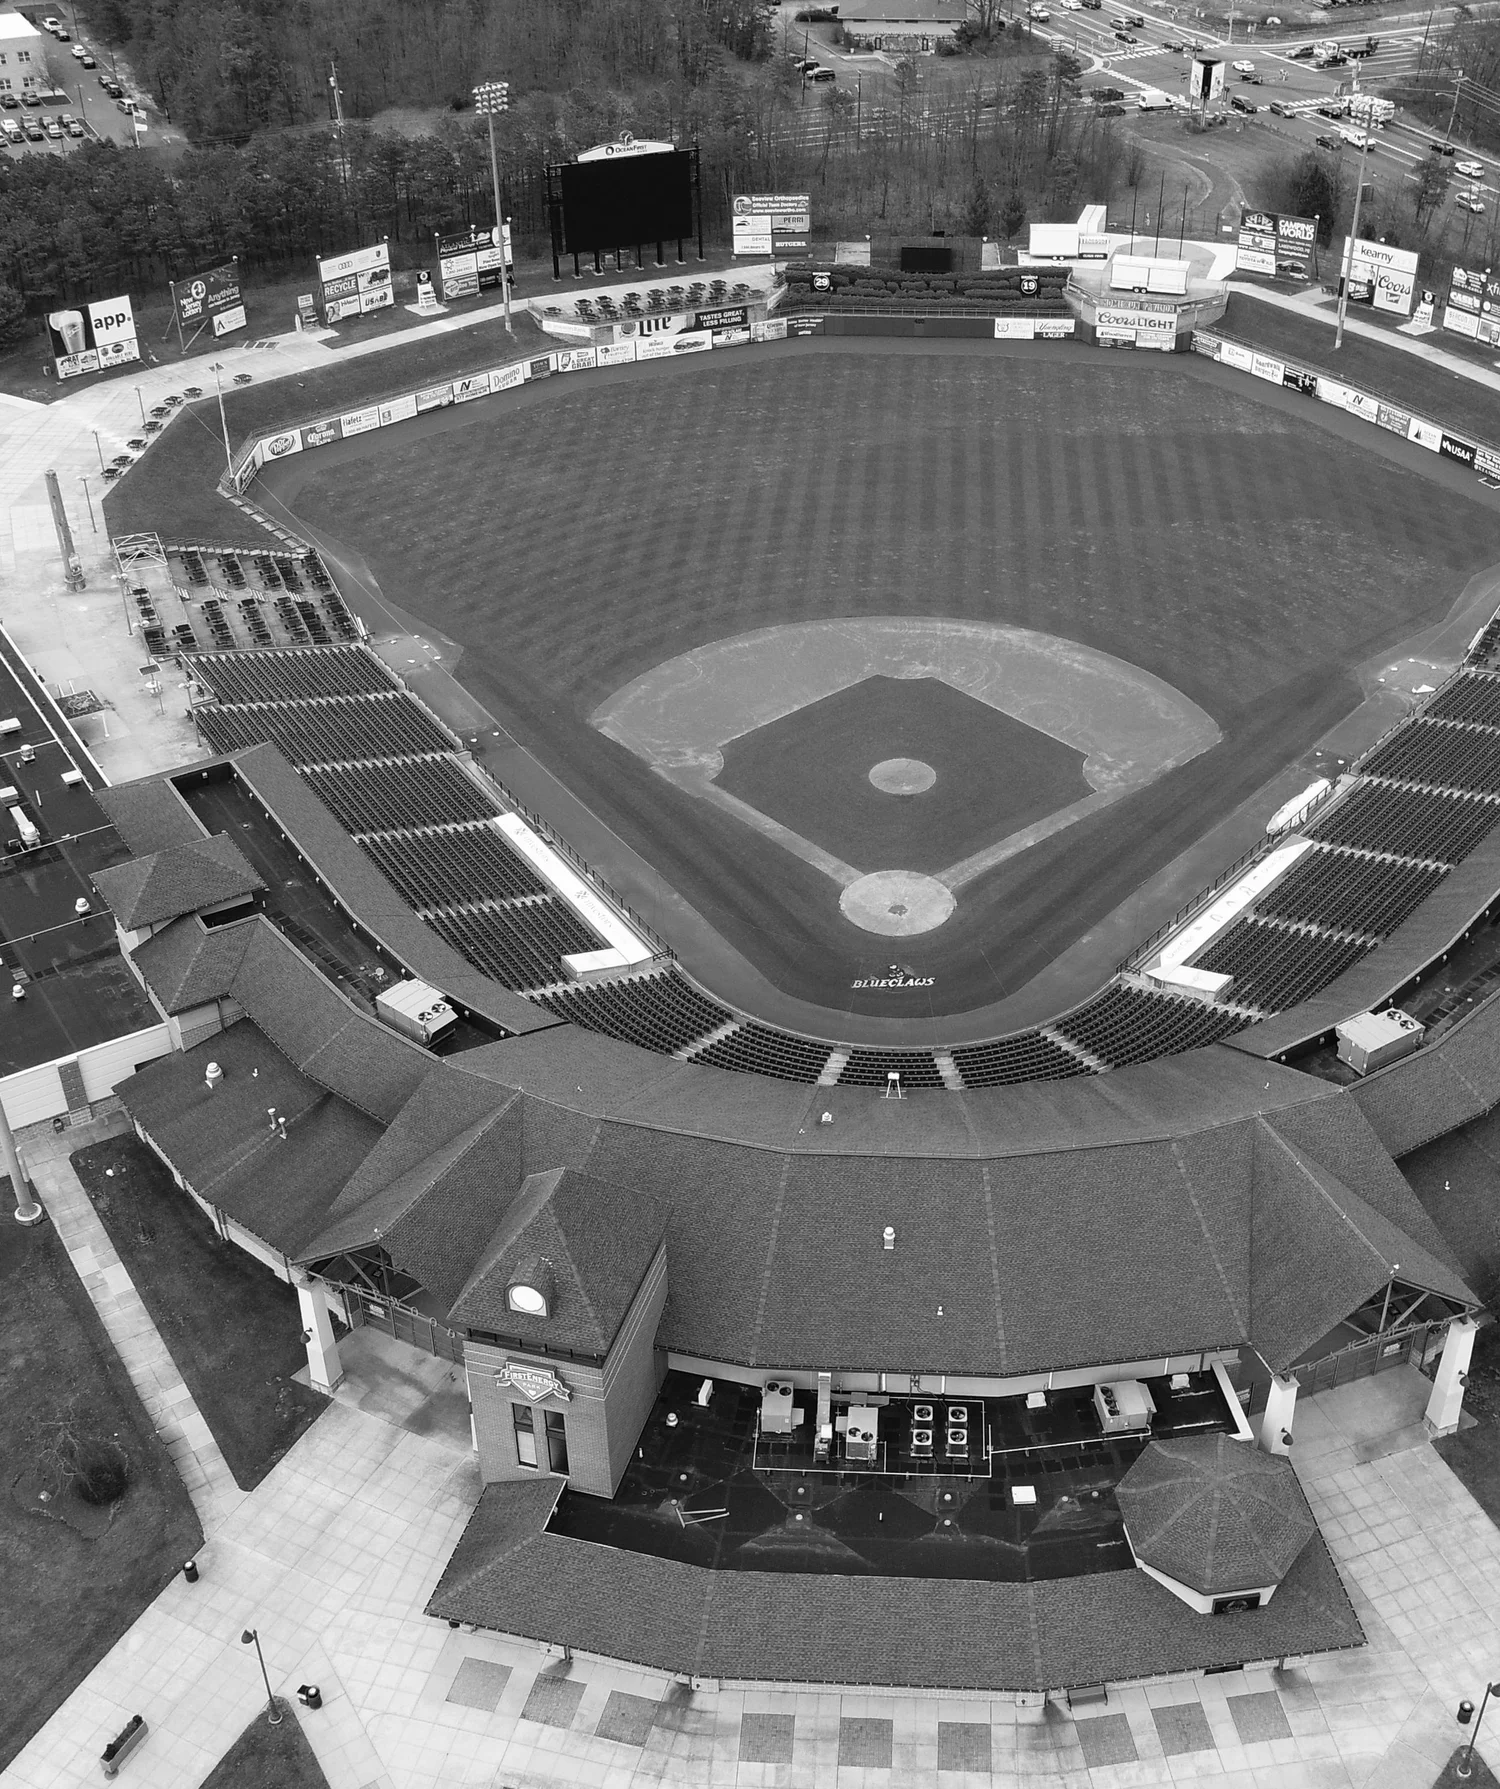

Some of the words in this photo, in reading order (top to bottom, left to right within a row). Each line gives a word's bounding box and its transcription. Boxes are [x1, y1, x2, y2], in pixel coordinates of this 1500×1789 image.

[1279, 219, 1315, 233] CAMPING
[1279, 226, 1314, 241] WORLD
[1361, 245, 1393, 264] kearny
[325, 280, 356, 296] RECYCLE
[815, 278, 828, 286] 29
[1023, 282, 1035, 290] 19
[1378, 274, 1410, 295] Coors
[180, 297, 193, 306] New
[208, 286, 239, 302] Anything
[182, 306, 202, 318] Lottery
[700, 313, 722, 321] TASTES
[723, 309, 744, 318] GREAT,
[93, 312, 131, 330] app.
[720, 316, 741, 325] FILLING
[1098, 311, 1136, 326] Coors
[1138, 317, 1174, 329] LIGHT
[493, 368, 520, 387] Domino
[307, 428, 335, 443] Corona
[1451, 445, 1470, 461] USAA
[851, 977, 935, 989] BLUECLAWS
[505, 1370, 559, 1389] FIRSTENERGY
[522, 1381, 540, 1390] PARK
